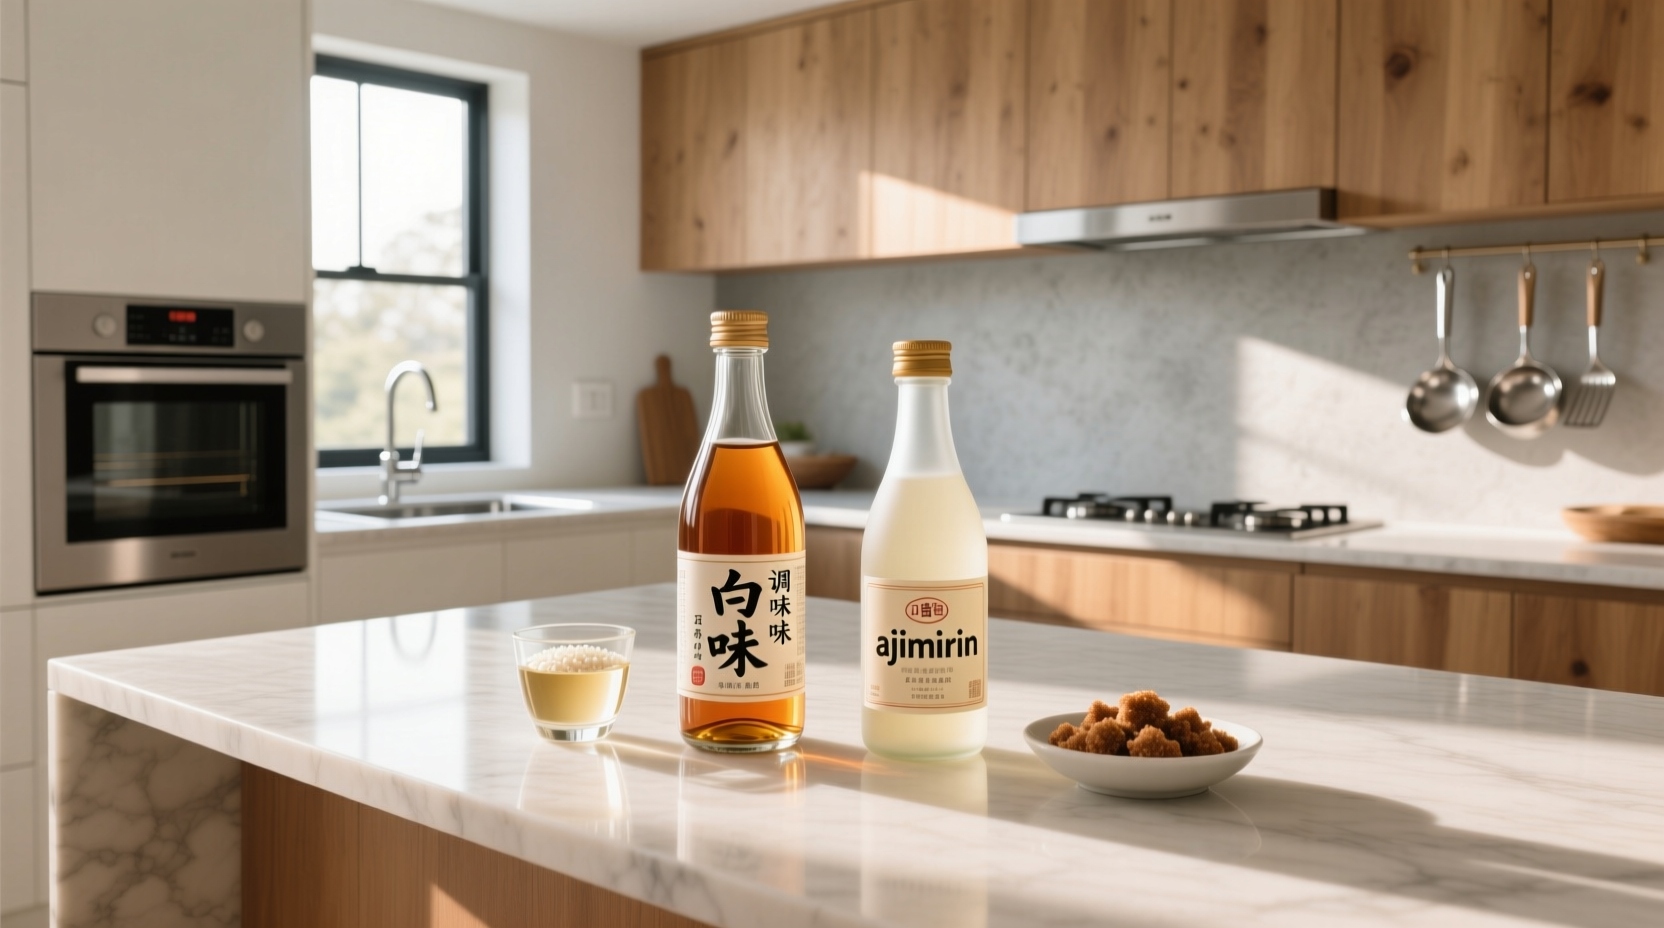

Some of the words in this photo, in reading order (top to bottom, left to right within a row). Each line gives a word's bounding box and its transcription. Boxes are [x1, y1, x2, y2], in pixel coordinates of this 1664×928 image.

[768, 569, 792, 645] 调味味
[876, 628, 978, 667] ajimirin
